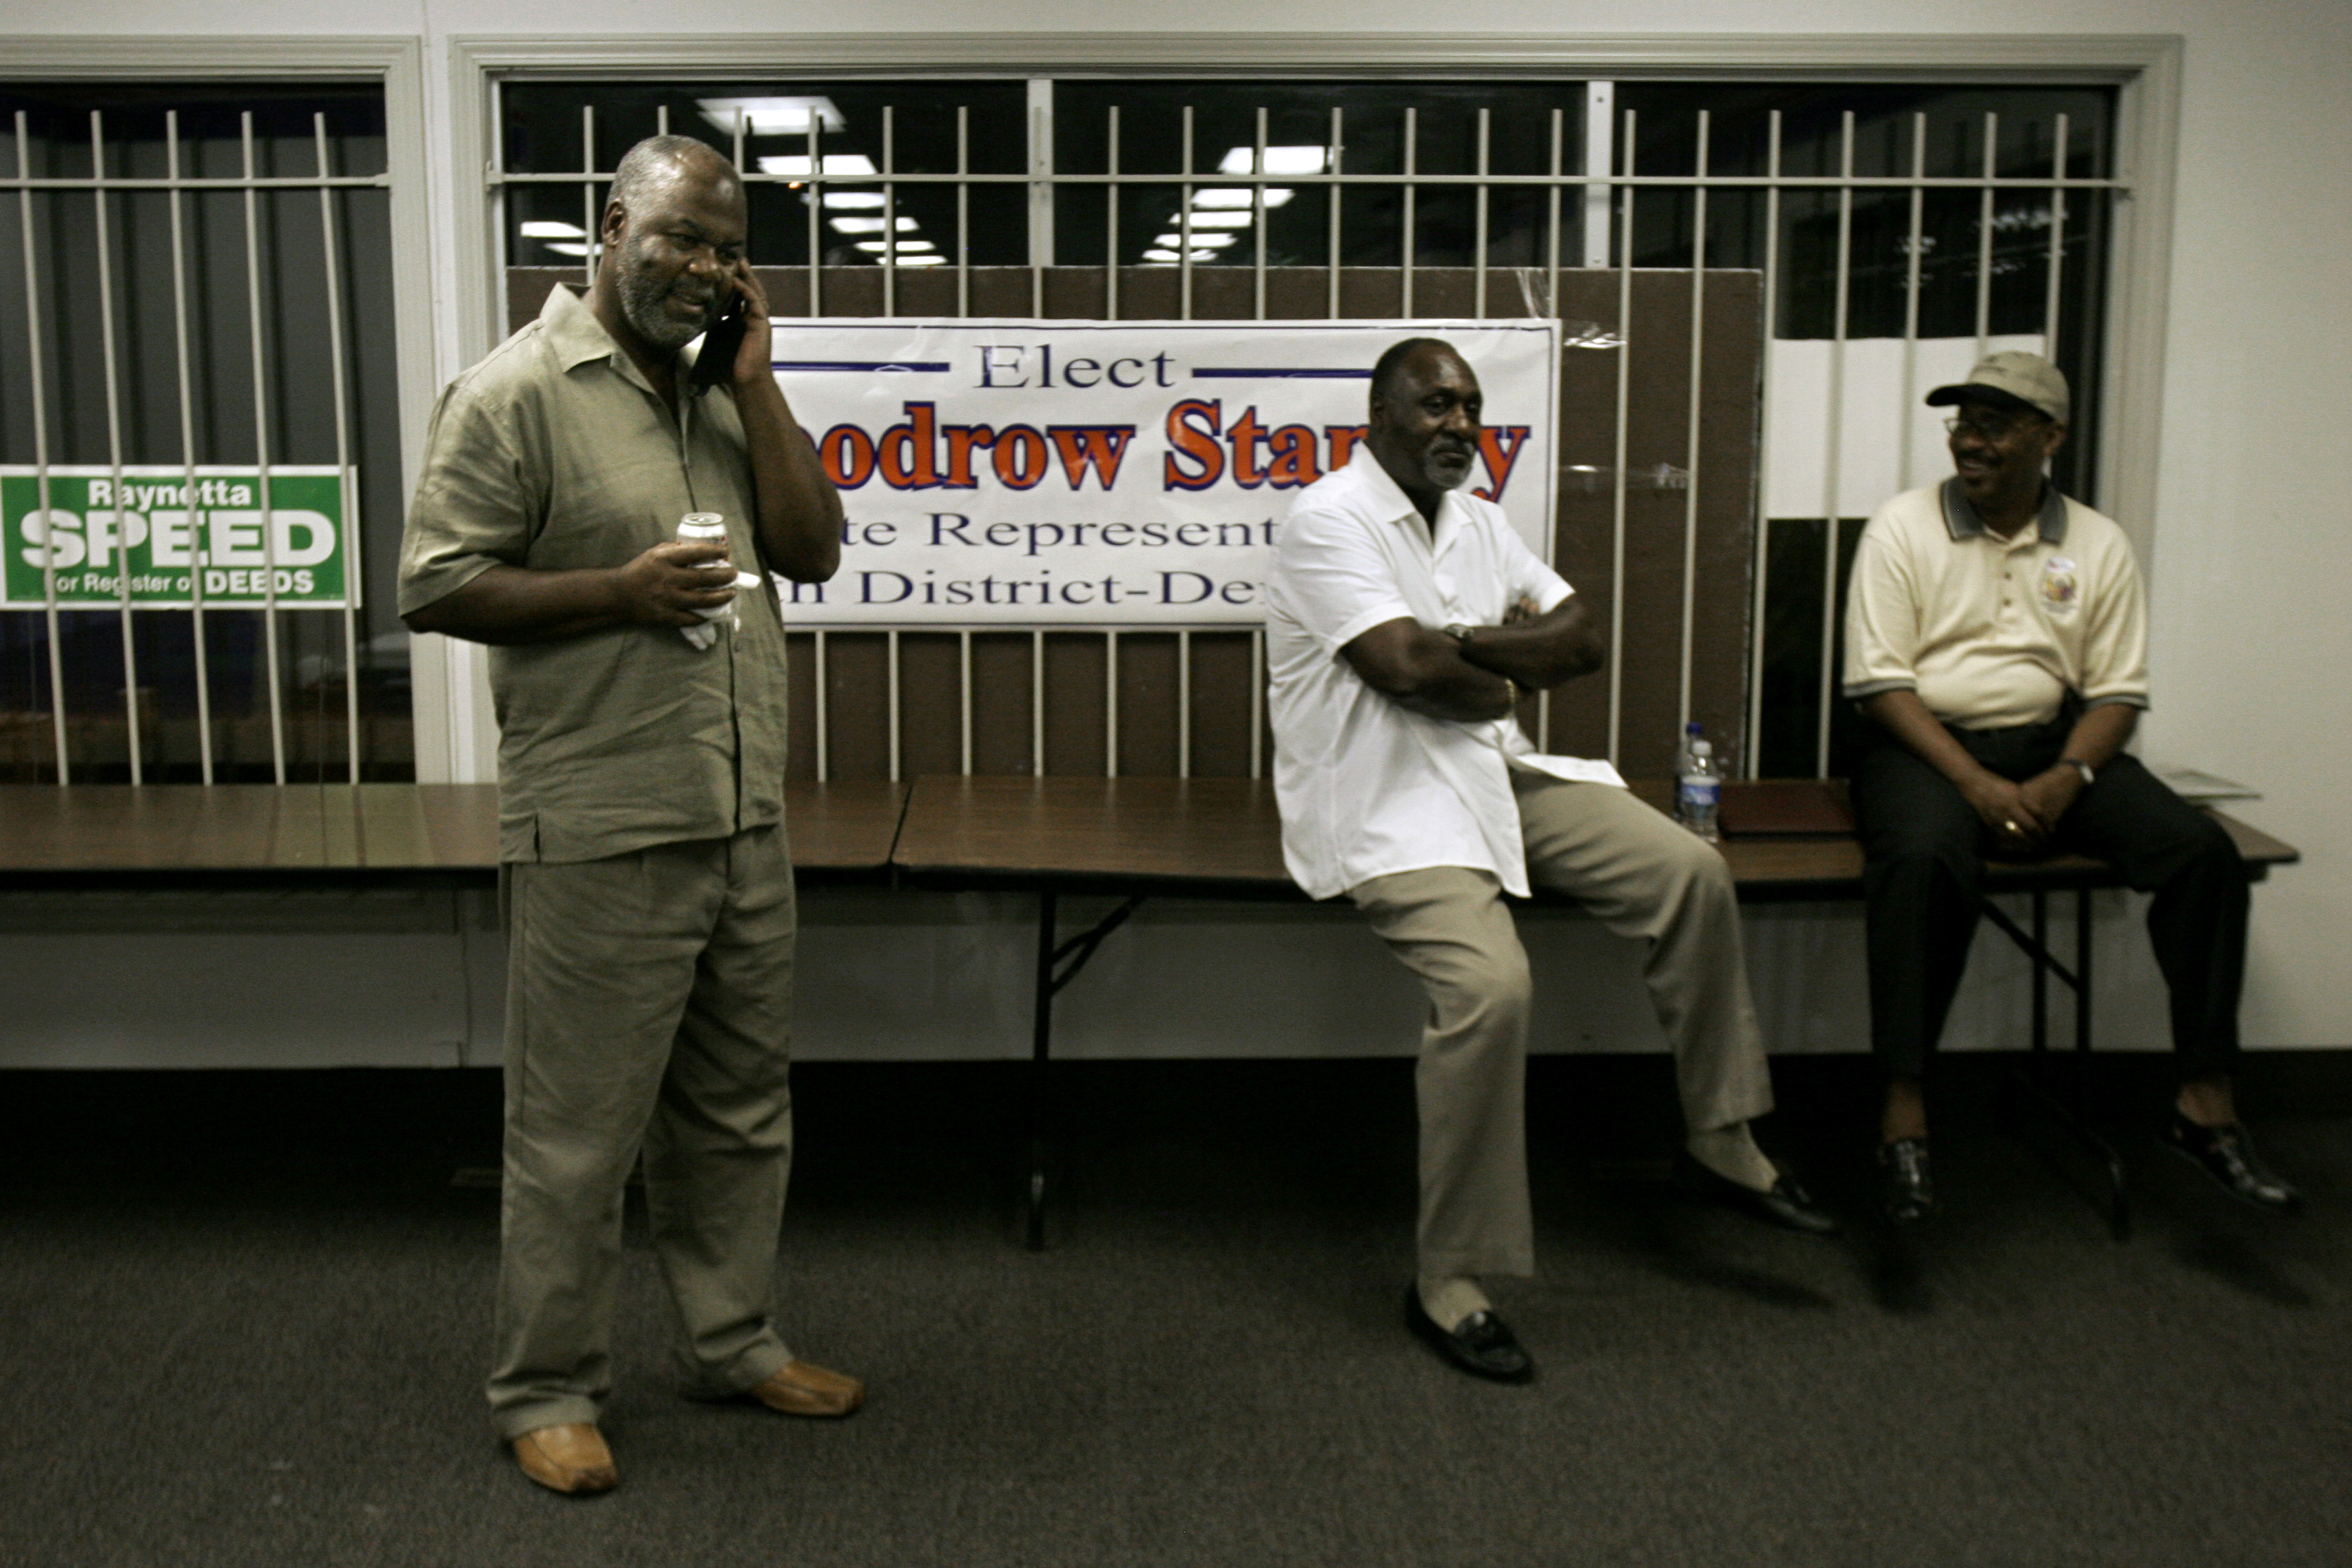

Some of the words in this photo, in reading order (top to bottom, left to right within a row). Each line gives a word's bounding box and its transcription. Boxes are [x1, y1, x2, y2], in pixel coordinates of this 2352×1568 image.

[975, 345, 1176, 388] Elect
[799, 402, 1135, 490] odrow
[89, 480, 251, 513] Raynetta
[21, 510, 336, 568] SPEED
[840, 517, 897, 546] te
[927, 513, 1279, 556] Represent
[52, 576, 79, 592] or
[83, 572, 171, 597] Regster
[176, 576, 194, 592] o
[206, 570, 314, 594] DEEDS
[854, 570, 1266, 604] District-De
